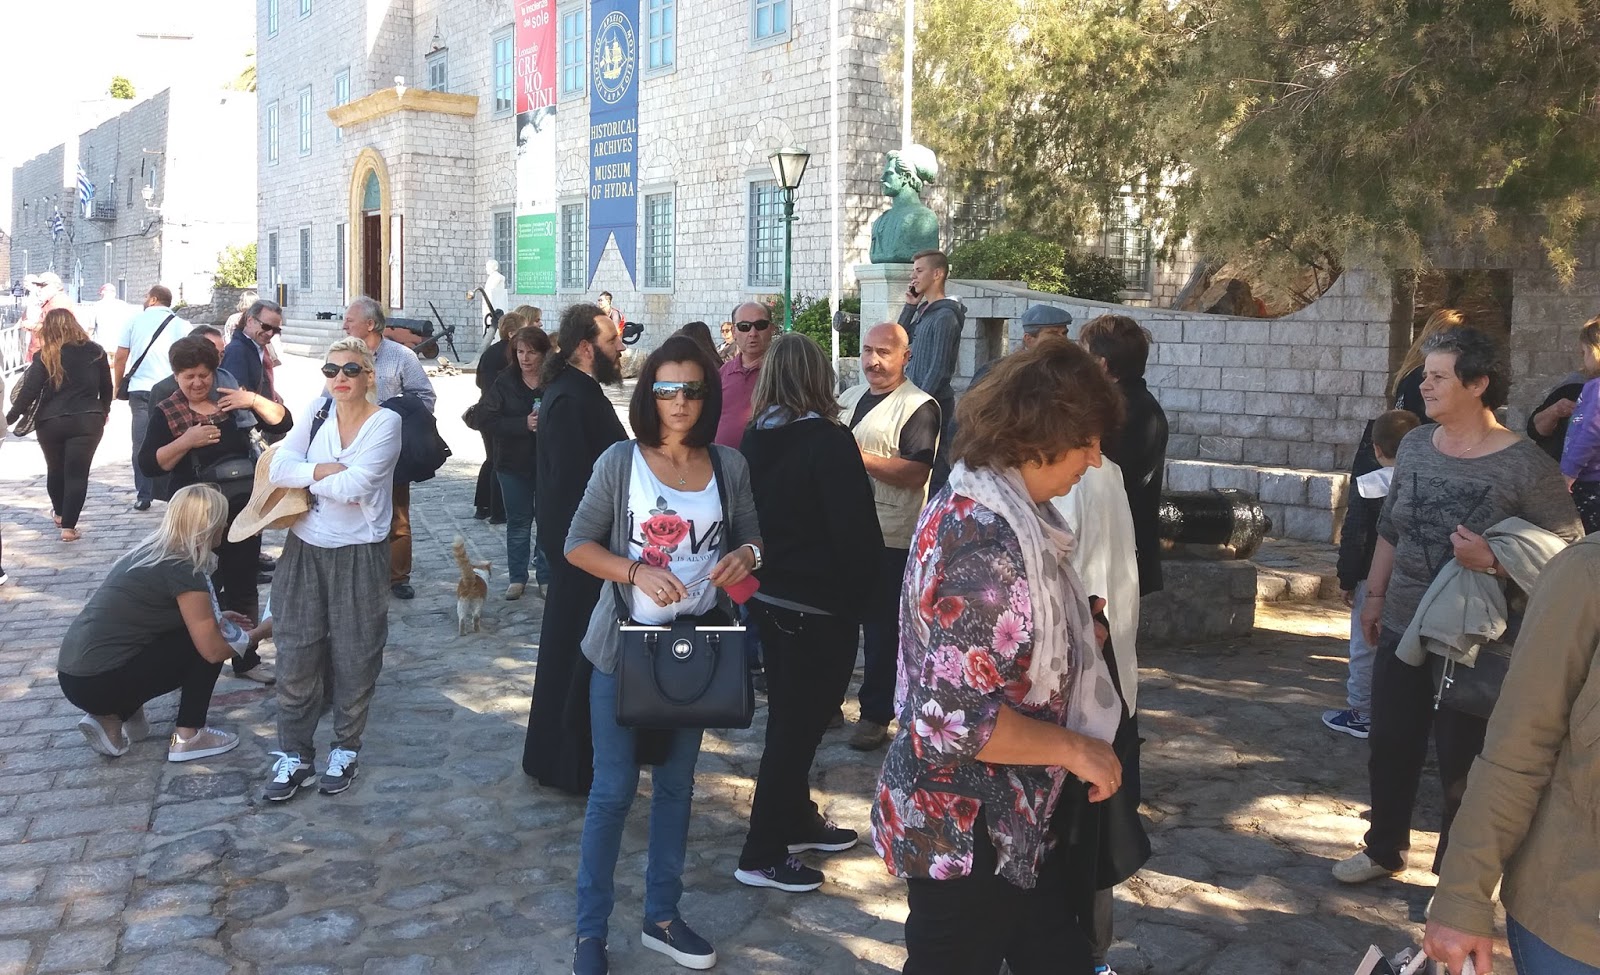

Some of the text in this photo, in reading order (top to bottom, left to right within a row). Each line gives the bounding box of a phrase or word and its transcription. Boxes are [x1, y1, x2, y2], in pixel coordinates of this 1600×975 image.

[531, 10, 549, 29] sole
[518, 54, 538, 77] CRE
[524, 71, 542, 94] MO
[527, 87, 553, 112] NINI
[591, 119, 637, 140] HISTORICAL
[593, 137, 633, 157] ARCHIVES
[595, 162, 631, 181] MUSEUM
[591, 181, 635, 200] OF HYDRA
[545, 221, 554, 237] 30
[627, 509, 725, 555] LV
